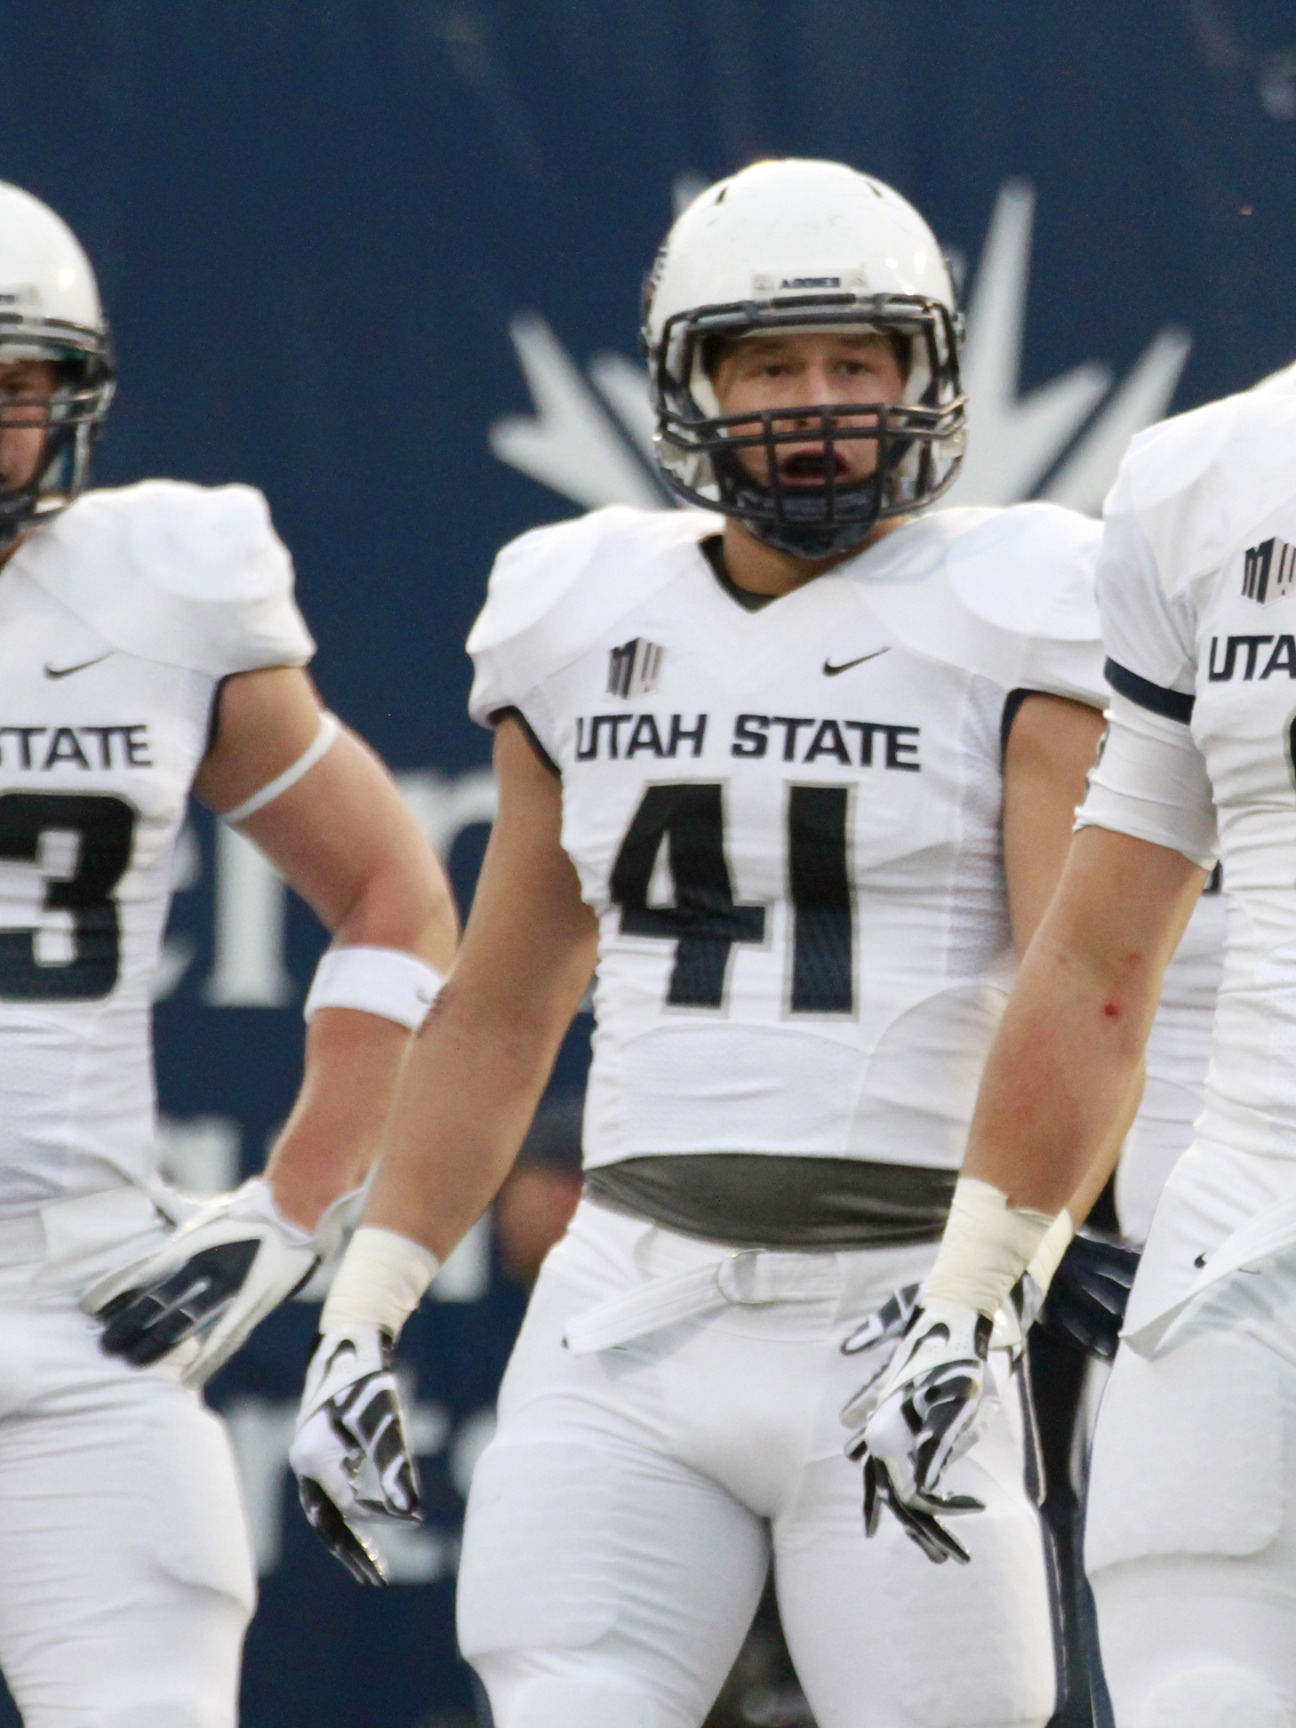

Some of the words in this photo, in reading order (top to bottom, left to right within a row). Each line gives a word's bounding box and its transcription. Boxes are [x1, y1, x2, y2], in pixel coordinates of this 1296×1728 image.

[0, 724, 153, 770] TATE
[574, 713, 708, 763] UTAH
[731, 714, 922, 772] STATE
[604, 776, 860, 1023] 41
